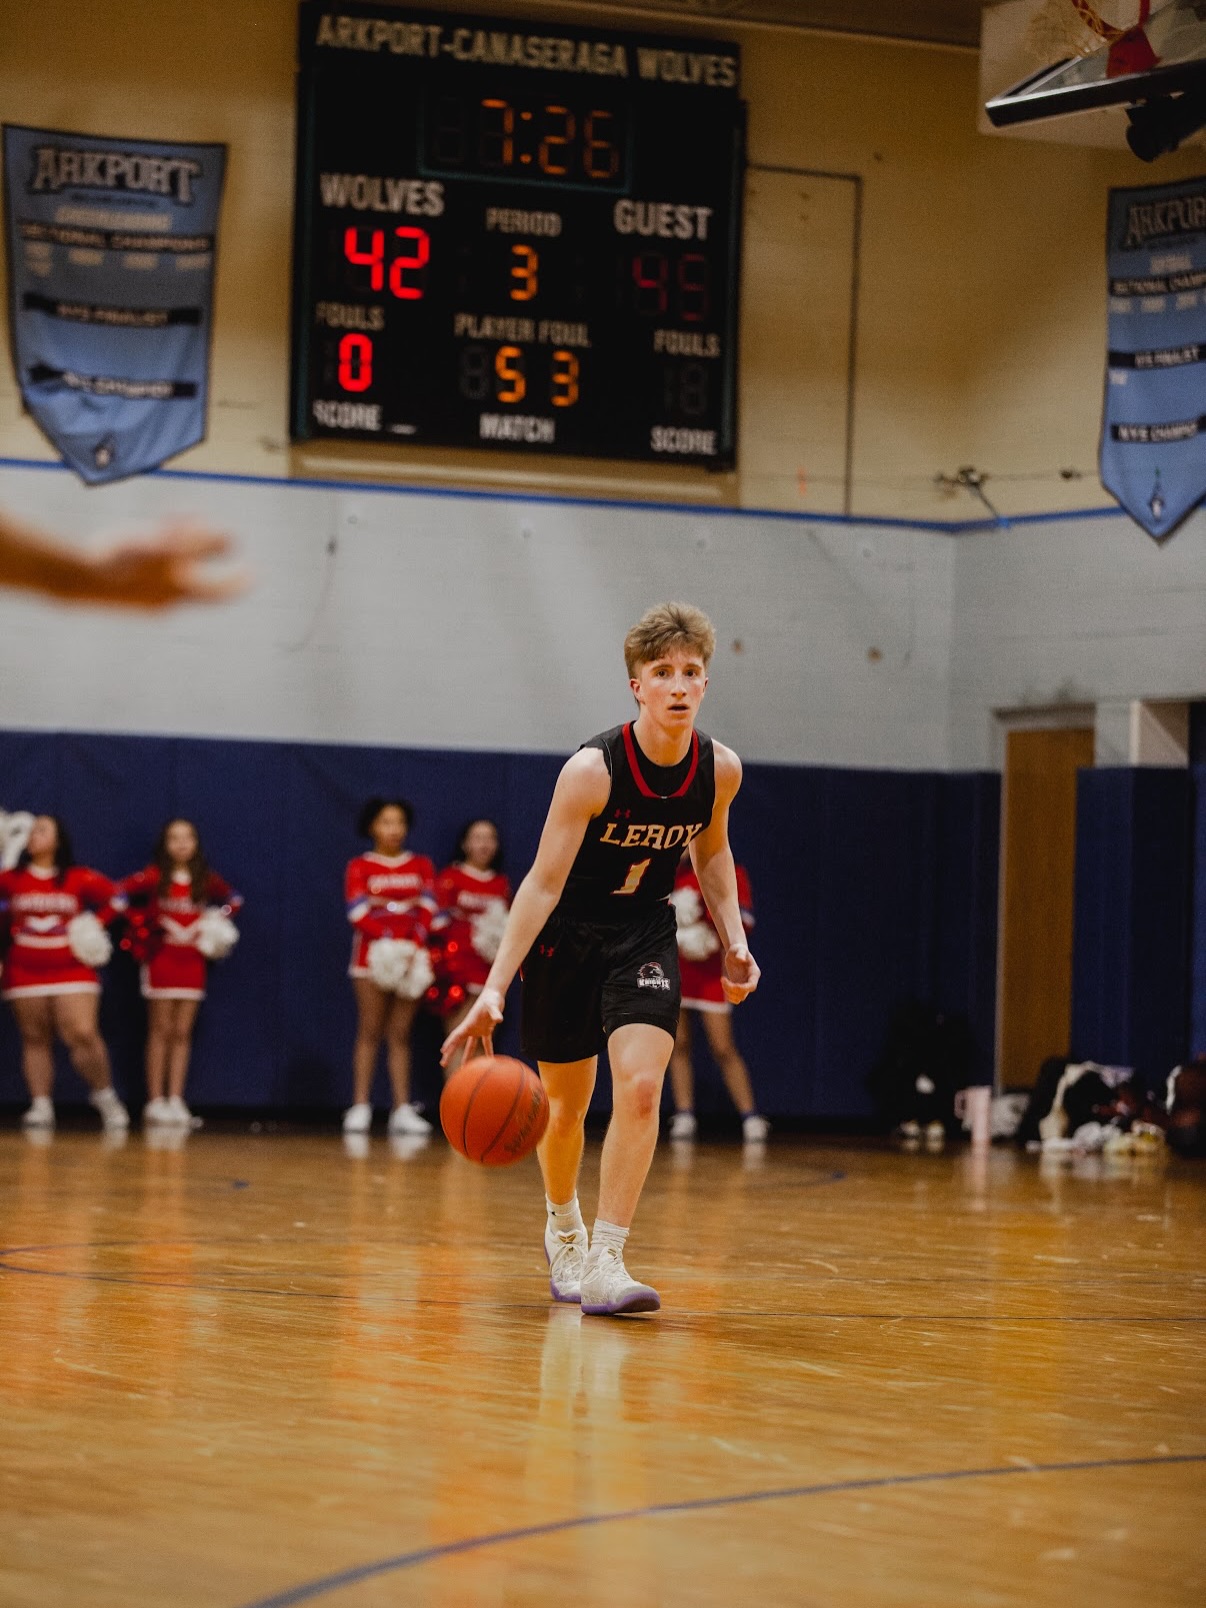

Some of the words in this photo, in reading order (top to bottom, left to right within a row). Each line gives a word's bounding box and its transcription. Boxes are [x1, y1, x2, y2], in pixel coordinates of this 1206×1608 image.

[316, 14, 629, 77] ARKPORT-CANASERAGA
[637, 46, 738, 88] WOLVES
[481, 98, 620, 179] 7:26
[32, 146, 202, 205] ARKPORT
[319, 171, 445, 217] WOLVES
[486, 206, 562, 238] PERIOD
[613, 199, 714, 240] GUEST
[344, 226, 431, 300] 42
[509, 244, 539, 301] 3
[315, 300, 385, 332] FOULS
[454, 311, 537, 344] PLAYER
[538, 316, 591, 348] FOUL
[653, 327, 720, 358] FOULS
[338, 333, 373, 393] 0
[494, 345, 526, 403] 5
[551, 350, 580, 407] 3
[312, 399, 382, 432] SCORE
[479, 412, 556, 444] MATCH
[650, 425, 718, 456] SCORE
[599, 822, 703, 851] LEROY
[611, 857, 651, 896] 1
[637, 977, 671, 990] KNIGHTS
